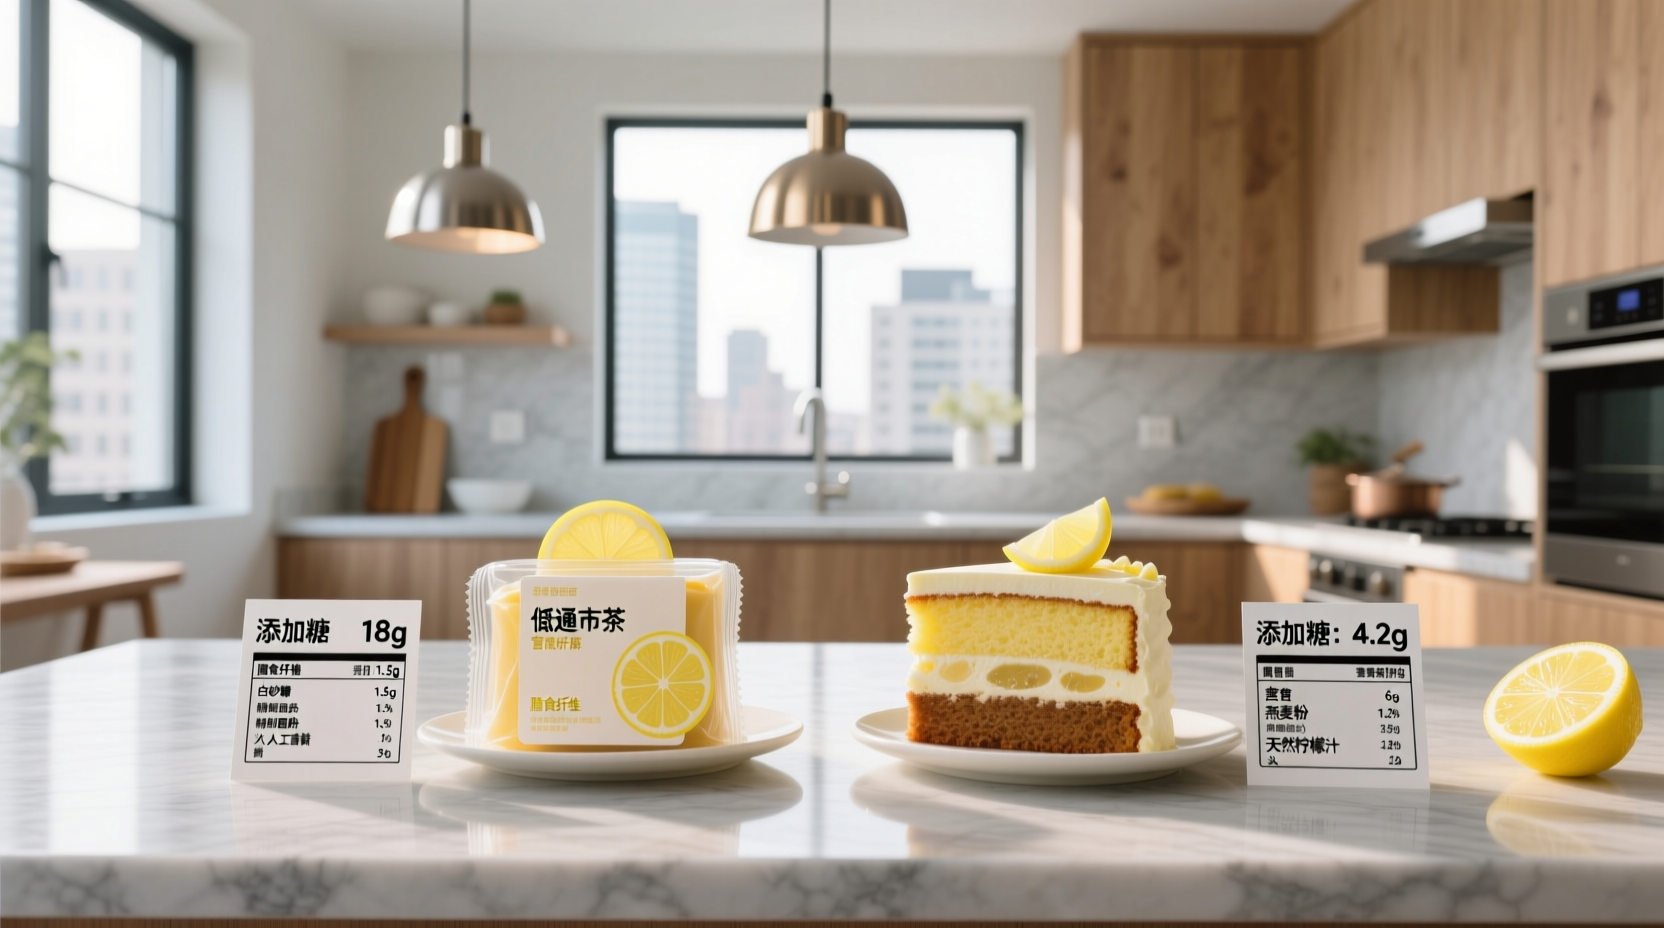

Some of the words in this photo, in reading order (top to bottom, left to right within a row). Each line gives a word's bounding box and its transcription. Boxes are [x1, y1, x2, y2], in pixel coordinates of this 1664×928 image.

[256, 617, 330, 644] 添加糖
[362, 619, 407, 649] 18g
[1352, 621, 1408, 652] 4.2g
